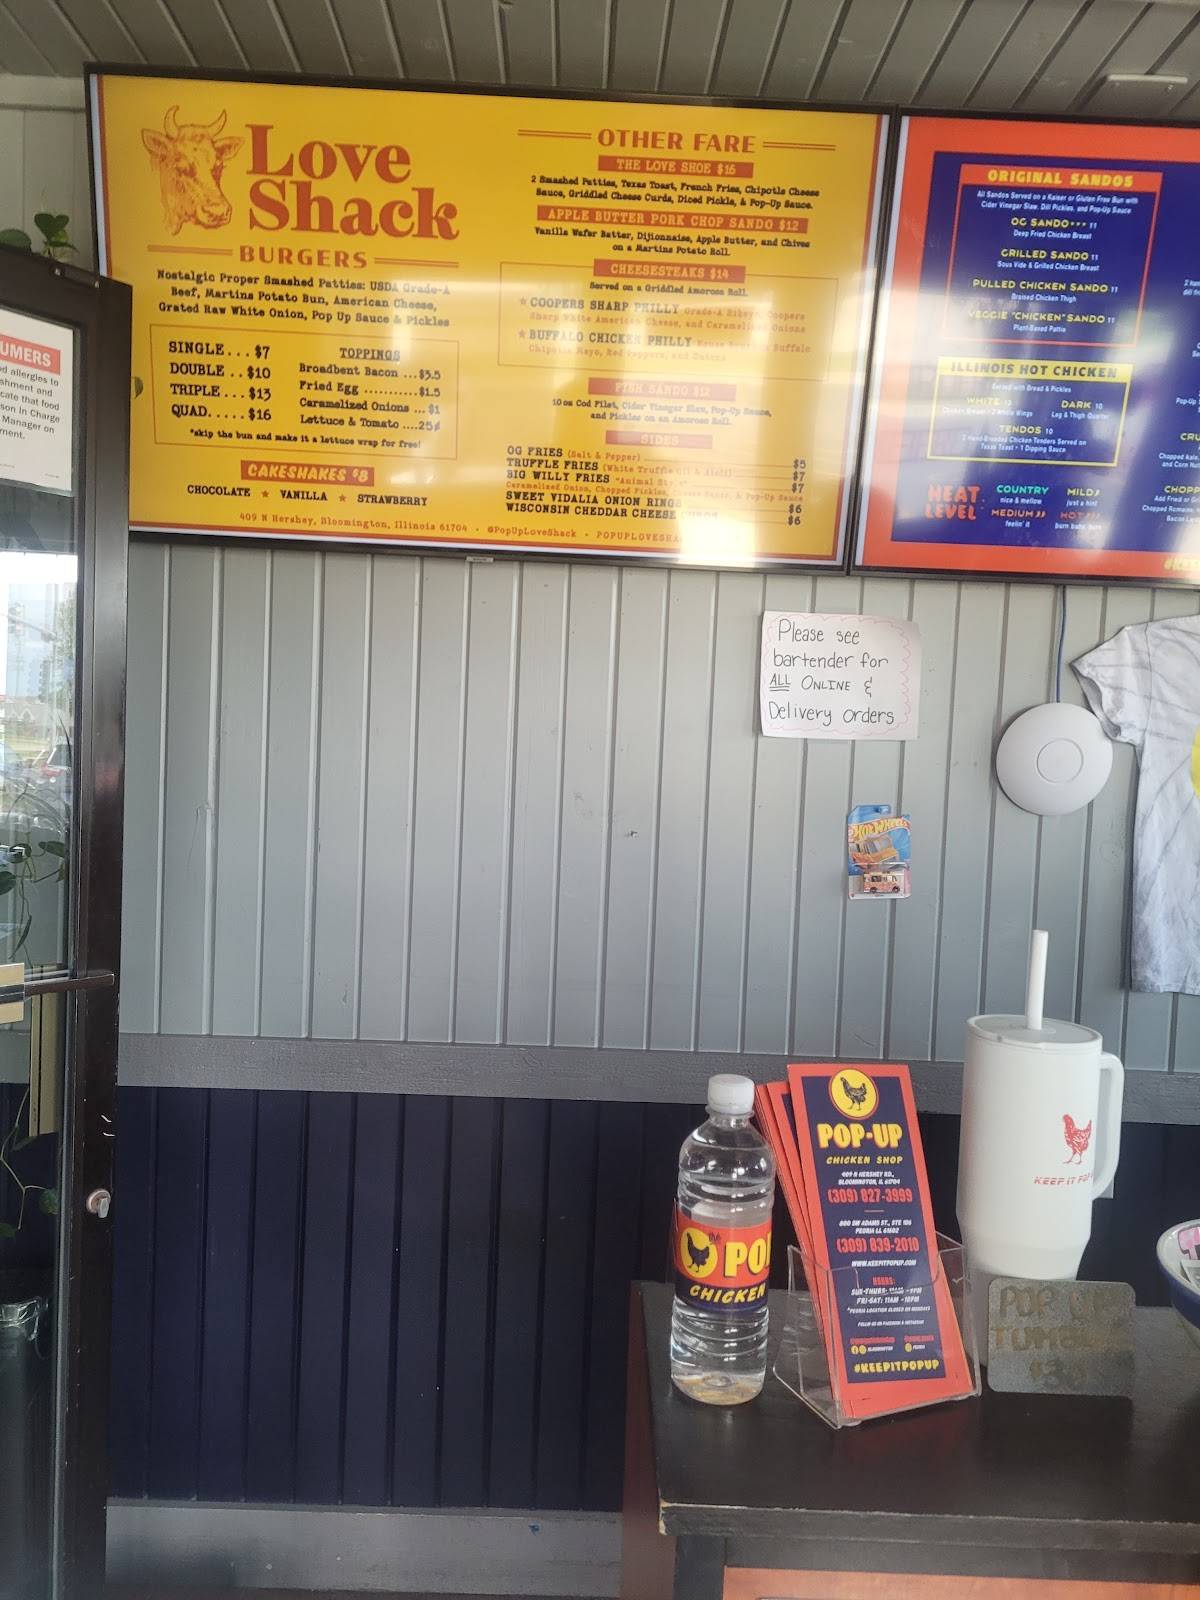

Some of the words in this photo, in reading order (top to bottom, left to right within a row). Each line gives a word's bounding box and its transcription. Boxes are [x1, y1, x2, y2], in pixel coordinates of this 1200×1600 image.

[598, 128, 683, 150] OTHER
[694, 133, 756, 153] FARE
[245, 123, 411, 184] Love
[617, 158, 640, 170] THE
[646, 160, 676, 172] LOVE
[681, 162, 711, 173] SHOE
[988, 170, 1062, 184] ORIGINAL
[1070, 173, 1133, 187] SANDOS
[249, 178, 460, 240] Shack
[548, 209, 589, 220] APPLE
[595, 211, 644, 223] BUTTER
[651, 214, 684, 225] PORK
[691, 216, 724, 227] CHOP
[729, 217, 773, 229] SANDO
[779, 219, 799, 231] $12
[1011, 217, 1026, 226] OG
[240, 245, 367, 268] BURGERS
[1001, 249, 1047, 258] GRILLED
[1050, 251, 1089, 260] SANDO
[610, 264, 704, 278] CHEESESTEAKS
[157, 269, 215, 284] Nostalgic
[220, 273, 259, 285] Proper
[264, 276, 314, 287] Smashed
[319, 279, 365, 290] Patties:
[370, 281, 398, 292] USDA
[973, 279, 1016, 289] PULLED
[1020, 281, 1066, 291] CHICKEN
[1070, 283, 1109, 293] SANDO
[172, 287, 200, 298] Beef,
[206, 288, 253, 299] Martins
[259, 292, 297, 302] Potato
[302, 294, 328, 305] Bun,
[334, 296, 388, 307] American
[530, 297, 584, 309] COOPERS
[590, 300, 628, 311] SHARP
[159, 302, 198, 313] Grated
[205, 305, 226, 315] Raw
[232, 306, 265, 316] White
[270, 308, 307, 320] Onion,
[312, 311, 332, 322] Pop
[338, 312, 351, 323] Up
[356, 313, 389, 323] Sauce
[255, 345, 270, 359] $7
[340, 348, 400, 361] TOPPINGS
[11, 369, 48, 385] allergies
[50, 375, 59, 387] to
[247, 366, 271, 379] $10
[300, 363, 360, 375] Broadbent
[365, 367, 398, 377] Bacon
[1020, 364, 1048, 375] HOT
[1053, 366, 1117, 378] CHICKEN
[37, 388, 52, 397] and
[249, 386, 271, 401] $13
[300, 380, 332, 391] Fried
[337, 382, 359, 395] Egg
[21, 395, 39, 406] that
[41, 400, 59, 412] food
[300, 398, 367, 410] Caramelized
[372, 402, 409, 413] Onions
[1061, 400, 1092, 409] DARK
[19, 405, 27, 416] In
[30, 409, 60, 424] Charge
[249, 408, 271, 421] $16
[300, 415, 344, 425] Lettuce
[348, 417, 356, 426] &
[360, 418, 399, 428] Tomato
[2, 415, 41, 432] Manager
[44, 425, 54, 434] on
[999, 425, 1041, 434] TENDOS
[507, 446, 522, 455] OG
[528, 447, 563, 457] FRIES
[793, 459, 806, 470] $5
[247, 463, 347, 482] CAKESHAKES
[352, 468, 368, 483] $8
[506, 458, 559, 469] TRUFFLE
[564, 461, 598, 471] FRIES
[793, 471, 805, 481] $7
[507, 470, 526, 479] BIG
[533, 471, 570, 481] WILLY
[576, 473, 610, 483] FRIES
[792, 483, 804, 493] $7
[996, 484, 1049, 495] COUNTRY
[187, 485, 250, 497] CHOCOLATE
[280, 489, 328, 501] VANILLA
[357, 494, 427, 506] STRAWBERRY
[506, 491, 545, 501] SWEET
[551, 493, 598, 504] VIDALIA
[605, 495, 640, 506] ONION
[789, 504, 802, 514] $6
[928, 484, 980, 504] HEAT
[506, 503, 570, 514] WISCONSIN
[574, 506, 628, 517] CHEDDAR
[632, 509, 676, 520] CHEESE
[788, 515, 801, 526] $6
[925, 503, 977, 520] LEVEL
[992, 509, 1033, 517] MEDIUM
[239, 512, 257, 522] 409
[262, 514, 268, 522] N
[272, 514, 317, 527] Hershey,
[321, 517, 391, 529] Bloomington,
[395, 520, 435, 530] Illinois
[487, 525, 576, 537] @PopUpLoveShack
[778, 618, 824, 643] Please
[836, 630, 860, 645] see
[773, 648, 854, 669] bartender
[860, 652, 889, 669] for
[769, 673, 791, 690] ALL
[864, 676, 873, 698] &
[768, 701, 832, 726] Delivery
[842, 707, 894, 725] orders
[817, 1123, 903, 1149] POP-UP
[826, 1156, 870, 1165] CHICKEN
[876, 1156, 903, 1164] SHOP
[1034, 1176, 1064, 1186] KEEP
[1067, 1176, 1078, 1185] IT
[690, 1283, 766, 1304] CHICKEN
[854, 1359, 939, 1373] #KEEPITPOPUP
